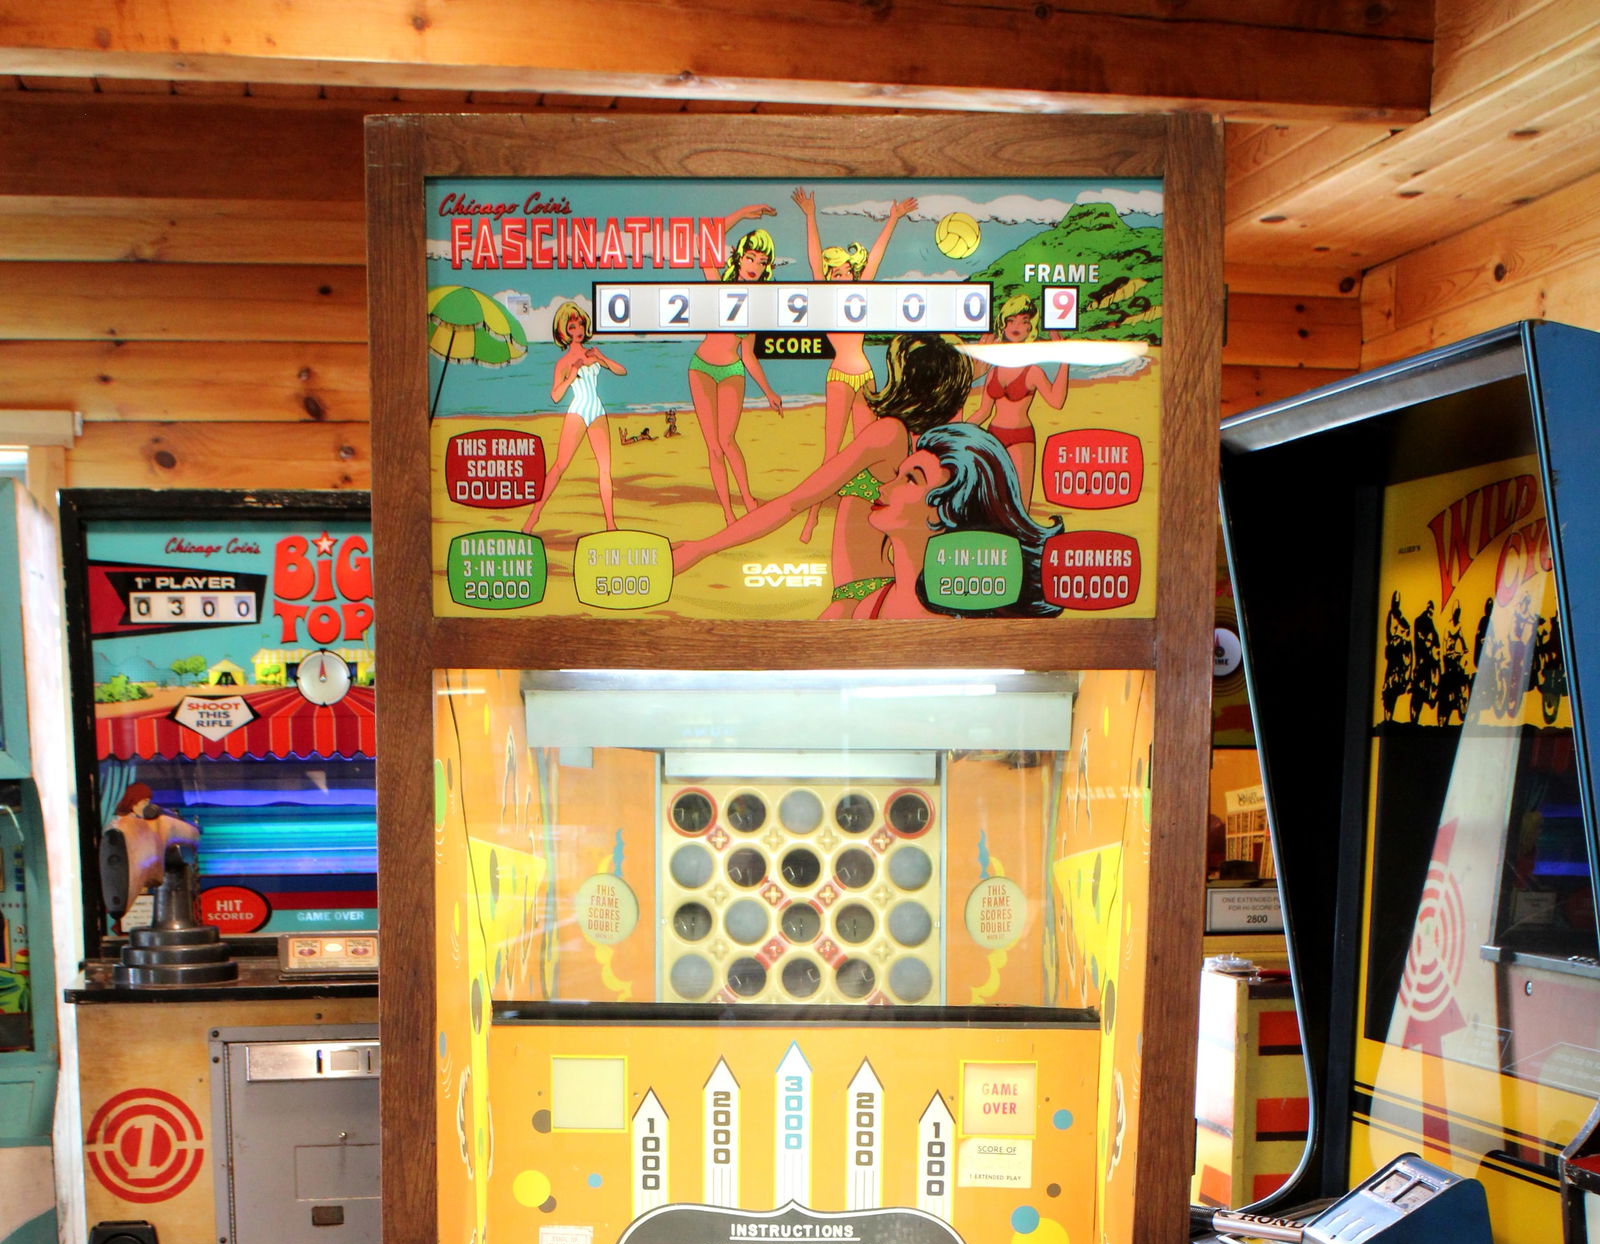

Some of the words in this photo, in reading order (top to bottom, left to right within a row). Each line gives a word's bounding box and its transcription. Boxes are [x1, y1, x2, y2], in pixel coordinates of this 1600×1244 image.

[439, 192, 520, 220] Chicago
[523, 192, 573, 215] Coin's
[451, 217, 727, 269] FASCINATION
[1024, 264, 1100, 284] FRAME
[1051, 290, 1076, 321] 9
[764, 338, 822, 355] SCORE
[456, 438, 487, 457] THIS
[491, 438, 536, 457] FRAME
[467, 460, 524, 478] SCORES
[1053, 470, 1131, 497] 100,000
[456, 481, 537, 501] DOUBLE
[164, 537, 222, 558] Chicago
[226, 537, 261, 554] Coin's
[461, 538, 534, 557] DIAGONAL
[1427, 473, 1538, 614] WILD
[1050, 549, 1060, 567] 4
[1064, 549, 1132, 568] CORNERS
[742, 562, 829, 575] GAME
[155, 576, 236, 590] PLAYER
[594, 575, 651, 597] 5,000
[743, 575, 824, 588] OVER
[939, 576, 1007, 598] 20,000
[1053, 575, 1130, 601] 100,000
[464, 580, 531, 602] 20,000
[273, 601, 375, 645] TOP
[187, 702, 241, 711] SHOOT
[198, 711, 231, 719] THIS
[195, 719, 233, 727] RIFLE
[597, 884, 617, 898] THIS
[987, 885, 1007, 896] THIS
[216, 899, 243, 912] HIT
[590, 896, 619, 909] FRAME
[982, 896, 1010, 908] FRAME
[207, 911, 254, 921] SCORED
[297, 910, 331, 922] GAME
[334, 909, 366, 922] OVER
[588, 908, 620, 921] SCORES
[980, 909, 1012, 921] SCORES
[1246, 914, 1268, 924] 2800
[588, 919, 620, 933] DOUBLE
[980, 921, 1012, 933] DOUBLE
[981, 1083, 1018, 1097] GAME
[983, 1102, 1017, 1115] OVER
[977, 1145, 1002, 1153] SCORE
[1006, 1146, 1017, 1154] OF
[974, 1173, 1005, 1181] EXTENDED
[731, 1223, 854, 1239] INSTRUCTIONS
